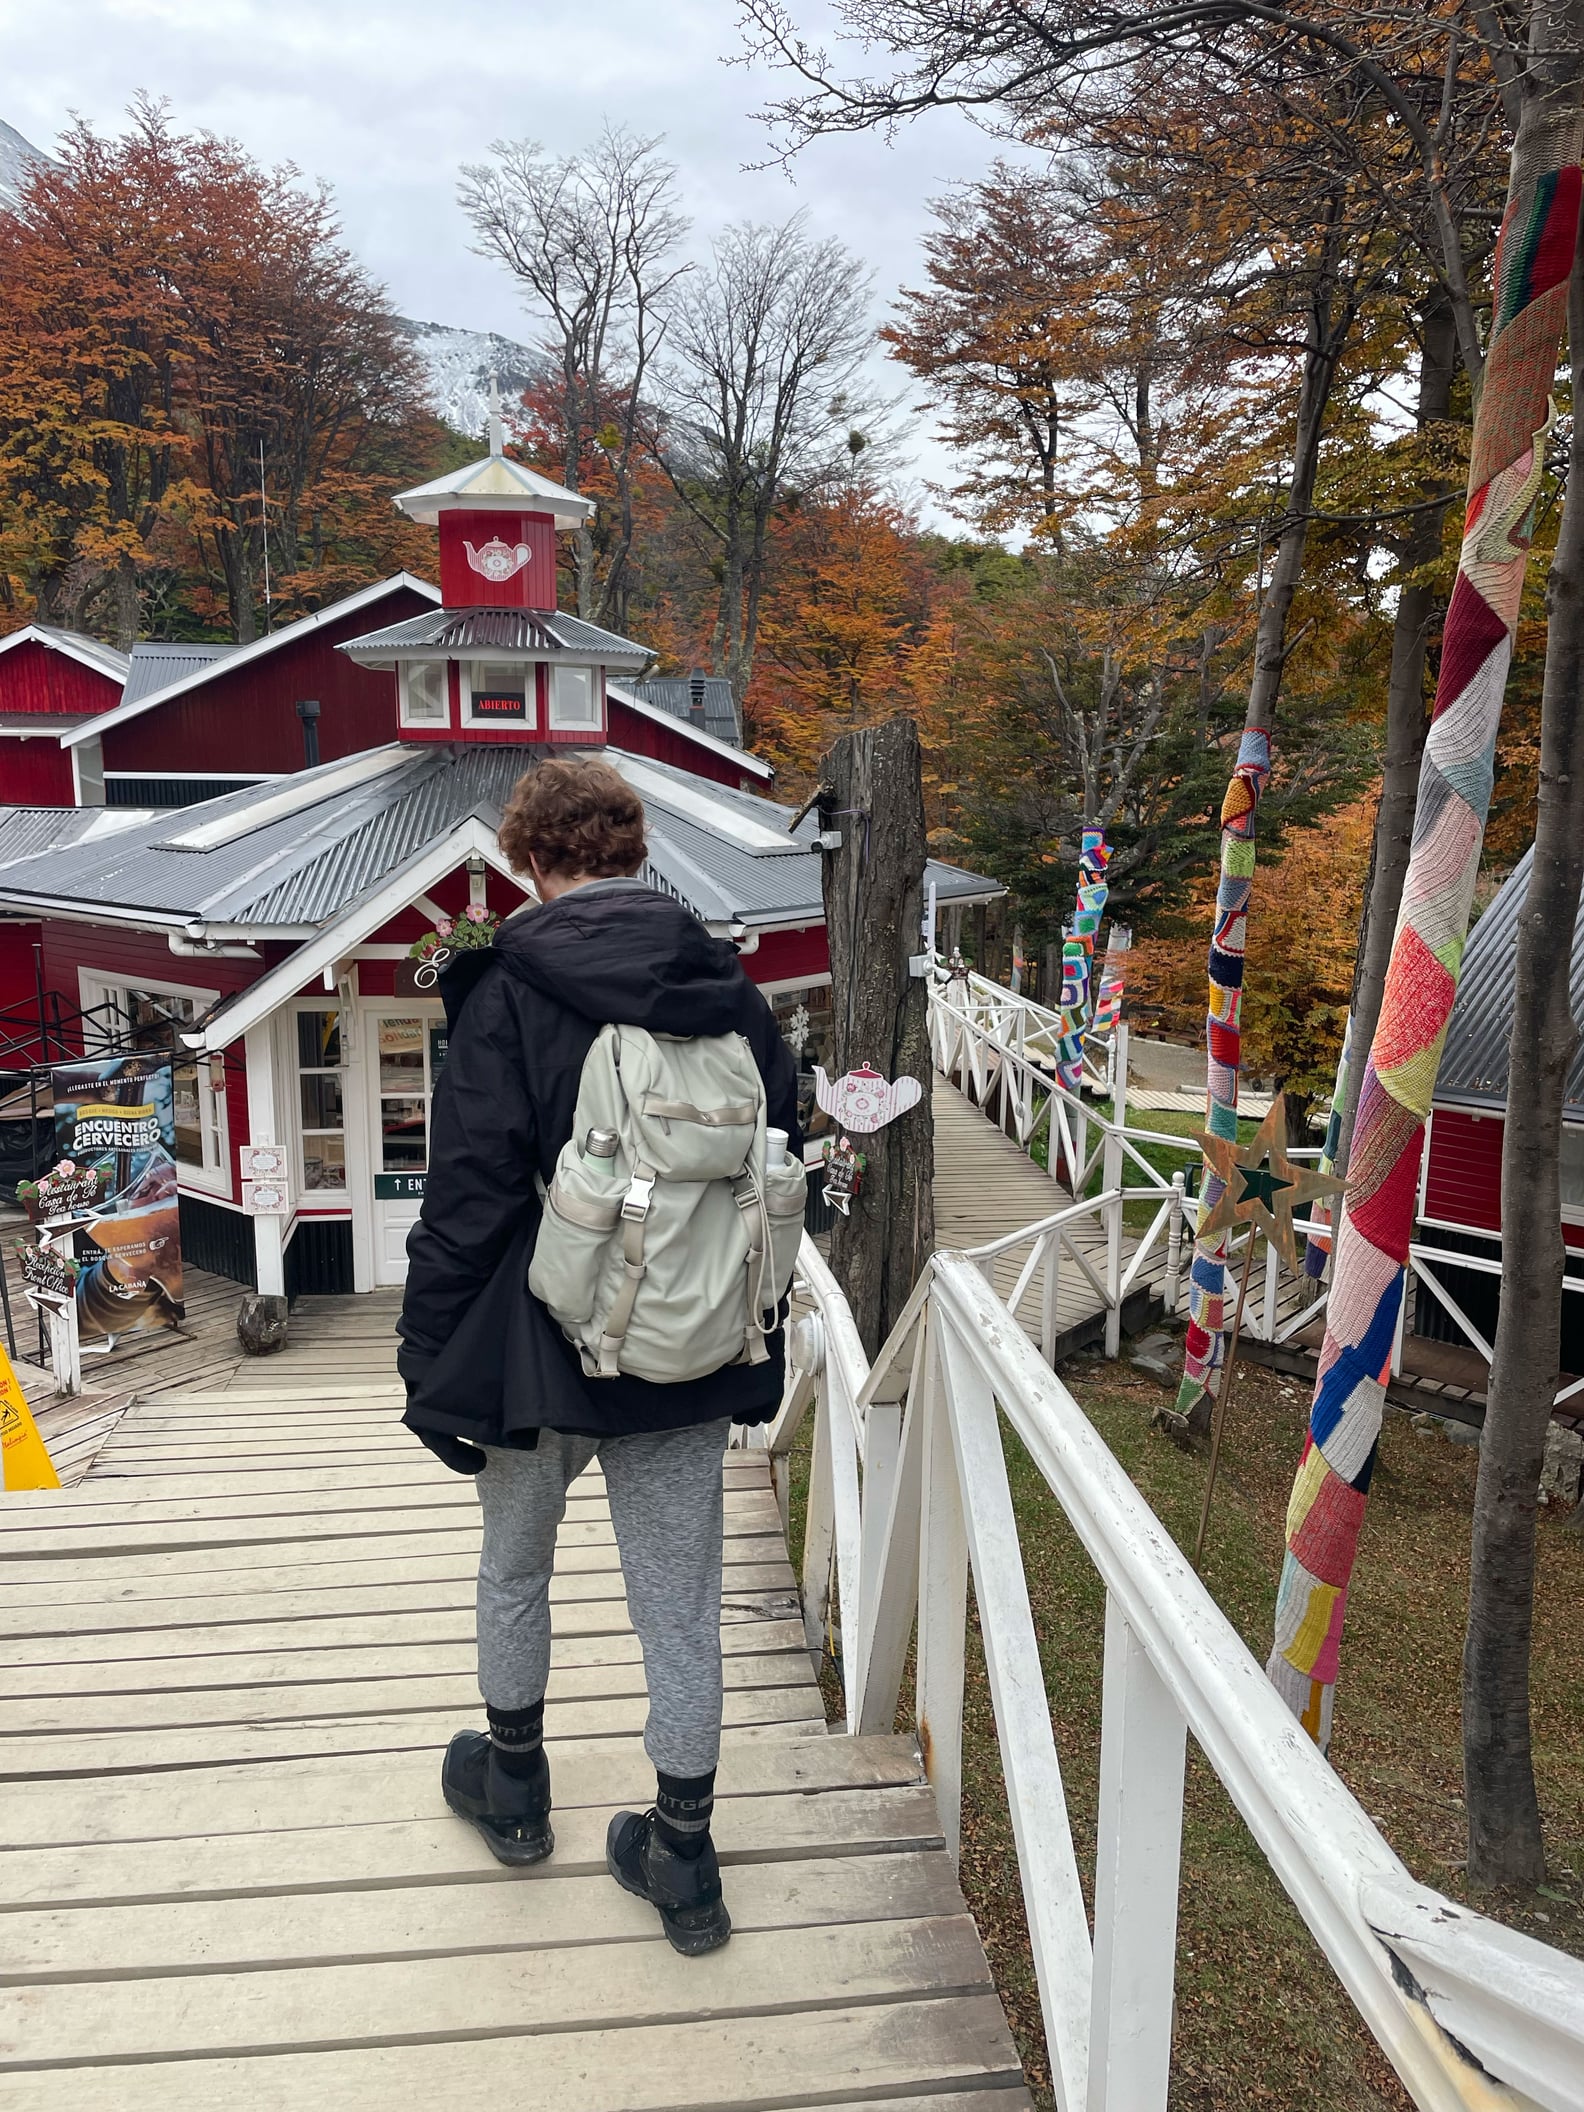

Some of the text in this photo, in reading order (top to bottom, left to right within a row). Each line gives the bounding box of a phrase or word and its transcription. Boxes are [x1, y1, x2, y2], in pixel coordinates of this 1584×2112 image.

[479, 699, 520, 710] ABIERTO
[110, 1078, 133, 1086] MOMENTO
[74, 1117, 158, 1138] ENCUENTRO
[72, 1128, 161, 1151] CERVECERO
[38, 1196, 62, 1208] Casa
[66, 1189, 78, 1202] de
[48, 1200, 90, 1216] Tea house
[112, 1242, 146, 1253] ESPERAMOS
[114, 1248, 147, 1259] CERVECERO
[108, 1280, 147, 1293] LA CABAÑA
